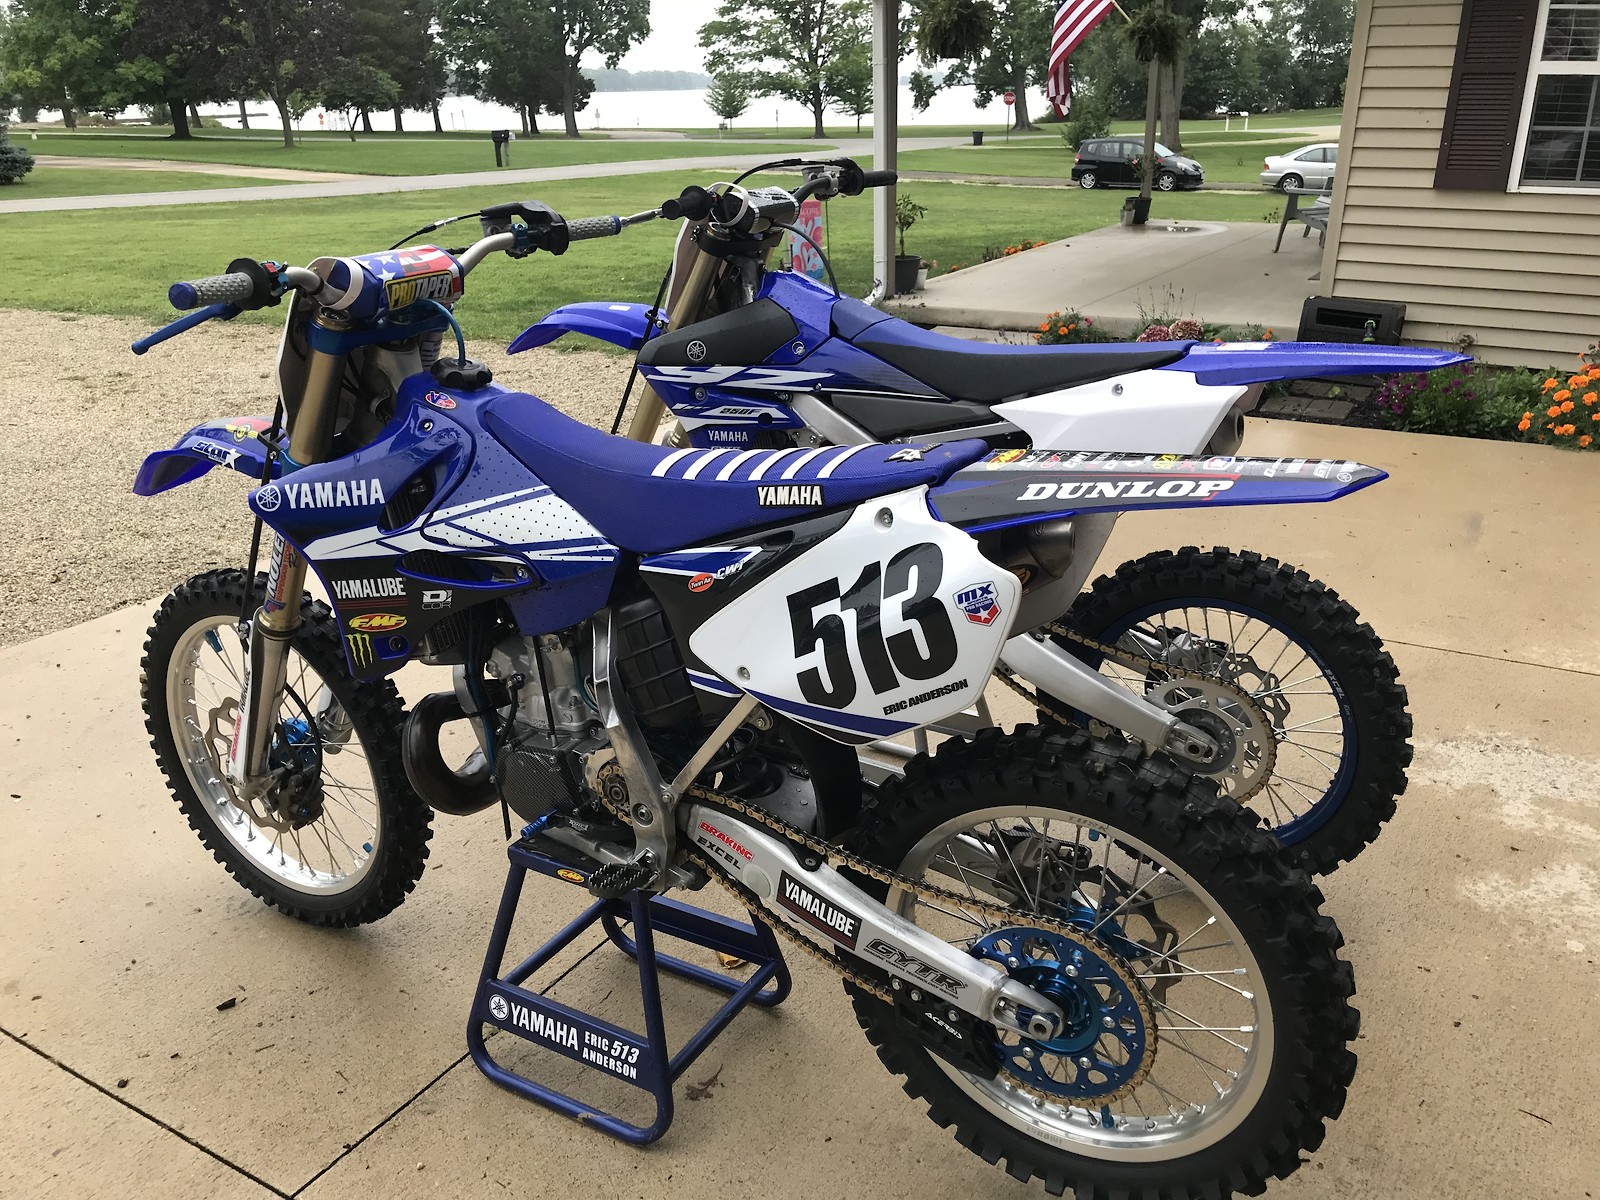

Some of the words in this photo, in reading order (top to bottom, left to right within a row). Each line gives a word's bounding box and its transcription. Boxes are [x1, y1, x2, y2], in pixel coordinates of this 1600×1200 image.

[708, 430, 748, 442] YAMAHA
[285, 478, 386, 509] YAMAHA
[757, 485, 823, 506] YAMAHA
[1016, 479, 1234, 501] DUNLOP
[331, 577, 407, 599] YAMALUBE
[349, 614, 407, 629] FMF
[786, 542, 958, 709] 513
[883, 700, 908, 716] ERIC
[908, 678, 969, 707] ANDERSON
[1325, 669, 1345, 699] EXCEL
[697, 836, 741, 870] EXCEL
[699, 821, 753, 861] BRAKING
[783, 878, 855, 938] YAMALUBE
[866, 939, 965, 995] GYTR
[510, 1002, 579, 1051] YAMAHA
[584, 1031, 609, 1051] ERIC
[610, 1040, 640, 1064] 513
[582, 1048, 637, 1080] ANDERSON
